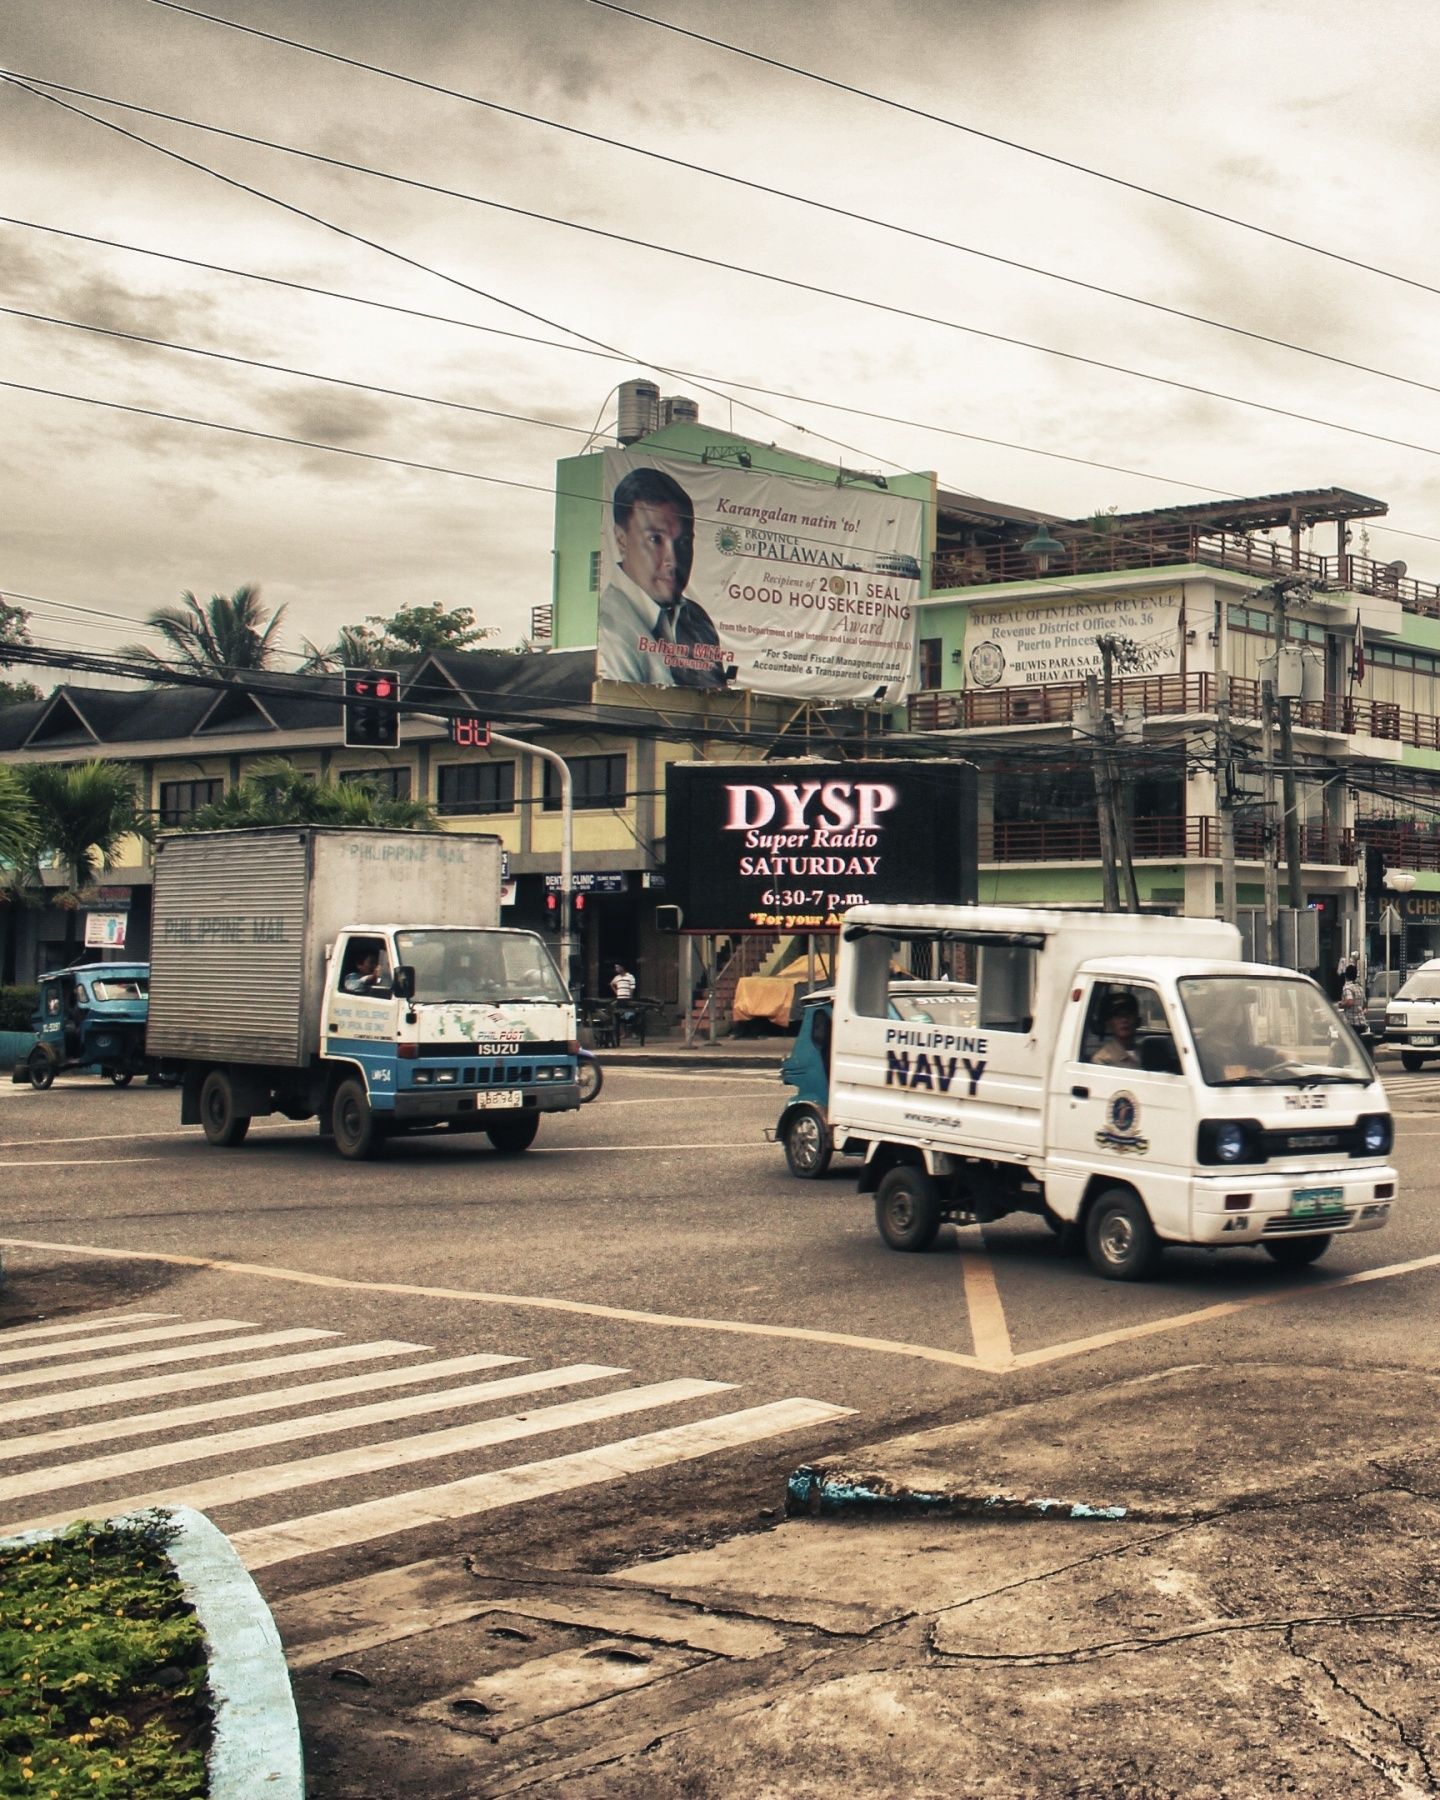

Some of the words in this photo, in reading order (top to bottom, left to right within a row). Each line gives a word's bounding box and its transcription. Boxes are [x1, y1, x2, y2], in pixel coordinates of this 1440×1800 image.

[716, 498, 797, 524] Karangalan
[801, 514, 837, 530] natin
[745, 529, 800, 546] PROVINCE
[744, 544, 756, 552] OF
[757, 541, 844, 568] PALAWAN
[763, 572, 803, 590] Recipient
[804, 577, 816, 591] of
[866, 583, 901, 601] SEAL
[728, 584, 782, 604] GOOD
[789, 592, 911, 620] HOUSEKEEPING
[973, 607, 1028, 626] BUREAU
[1027, 608, 1041, 620] OF
[1042, 602, 1110, 620] INTERNAL
[1114, 595, 1175, 612] REVENUE
[719, 622, 735, 631] from
[736, 623, 747, 632] the
[748, 625, 786, 638] Department
[786, 629, 794, 637] of
[794, 630, 805, 639] the
[805, 632, 829, 642] Interior
[830, 635, 842, 643] and
[843, 636, 858, 645] Local
[832, 615, 885, 636] Award
[992, 623, 1037, 639] Revenue
[1039, 618, 1080, 635] District
[1082, 616, 1116, 631] Office
[1119, 614, 1138, 627] No.
[1140, 612, 1154, 625] 36
[1017, 637, 1050, 652] Puerto
[1054, 633, 1098, 649] Princes
[752, 660, 803, 674] Accountable
[806, 666, 813, 674] &
[815, 666, 861, 680] Transparent
[783, 651, 808, 662] Sound
[810, 653, 835, 664] Fiscal
[836, 656, 884, 670] Management
[885, 661, 900, 671] and
[1049, 656, 1075, 669] PARA
[1077, 655, 1090, 667] SA
[1026, 669, 1060, 683] BUHAY
[1060, 668, 1075, 681] AT
[722, 781, 898, 831] DYSP
[744, 829, 808, 854] Super
[811, 829, 878, 849] Radio
[739, 856, 881, 876] SATURDAY
[572, 874, 595, 885] CLINIC
[762, 889, 824, 906] 6:30-7
[827, 893, 870, 910] p.m.
[164, 916, 246, 944] PHILIPPINE
[785, 914, 824, 928] your
[500, 1030, 525, 1040] POST
[886, 1028, 988, 1054] PHILIPPINE
[478, 1043, 519, 1055] ISUZU
[886, 1050, 987, 1096] NAVY
